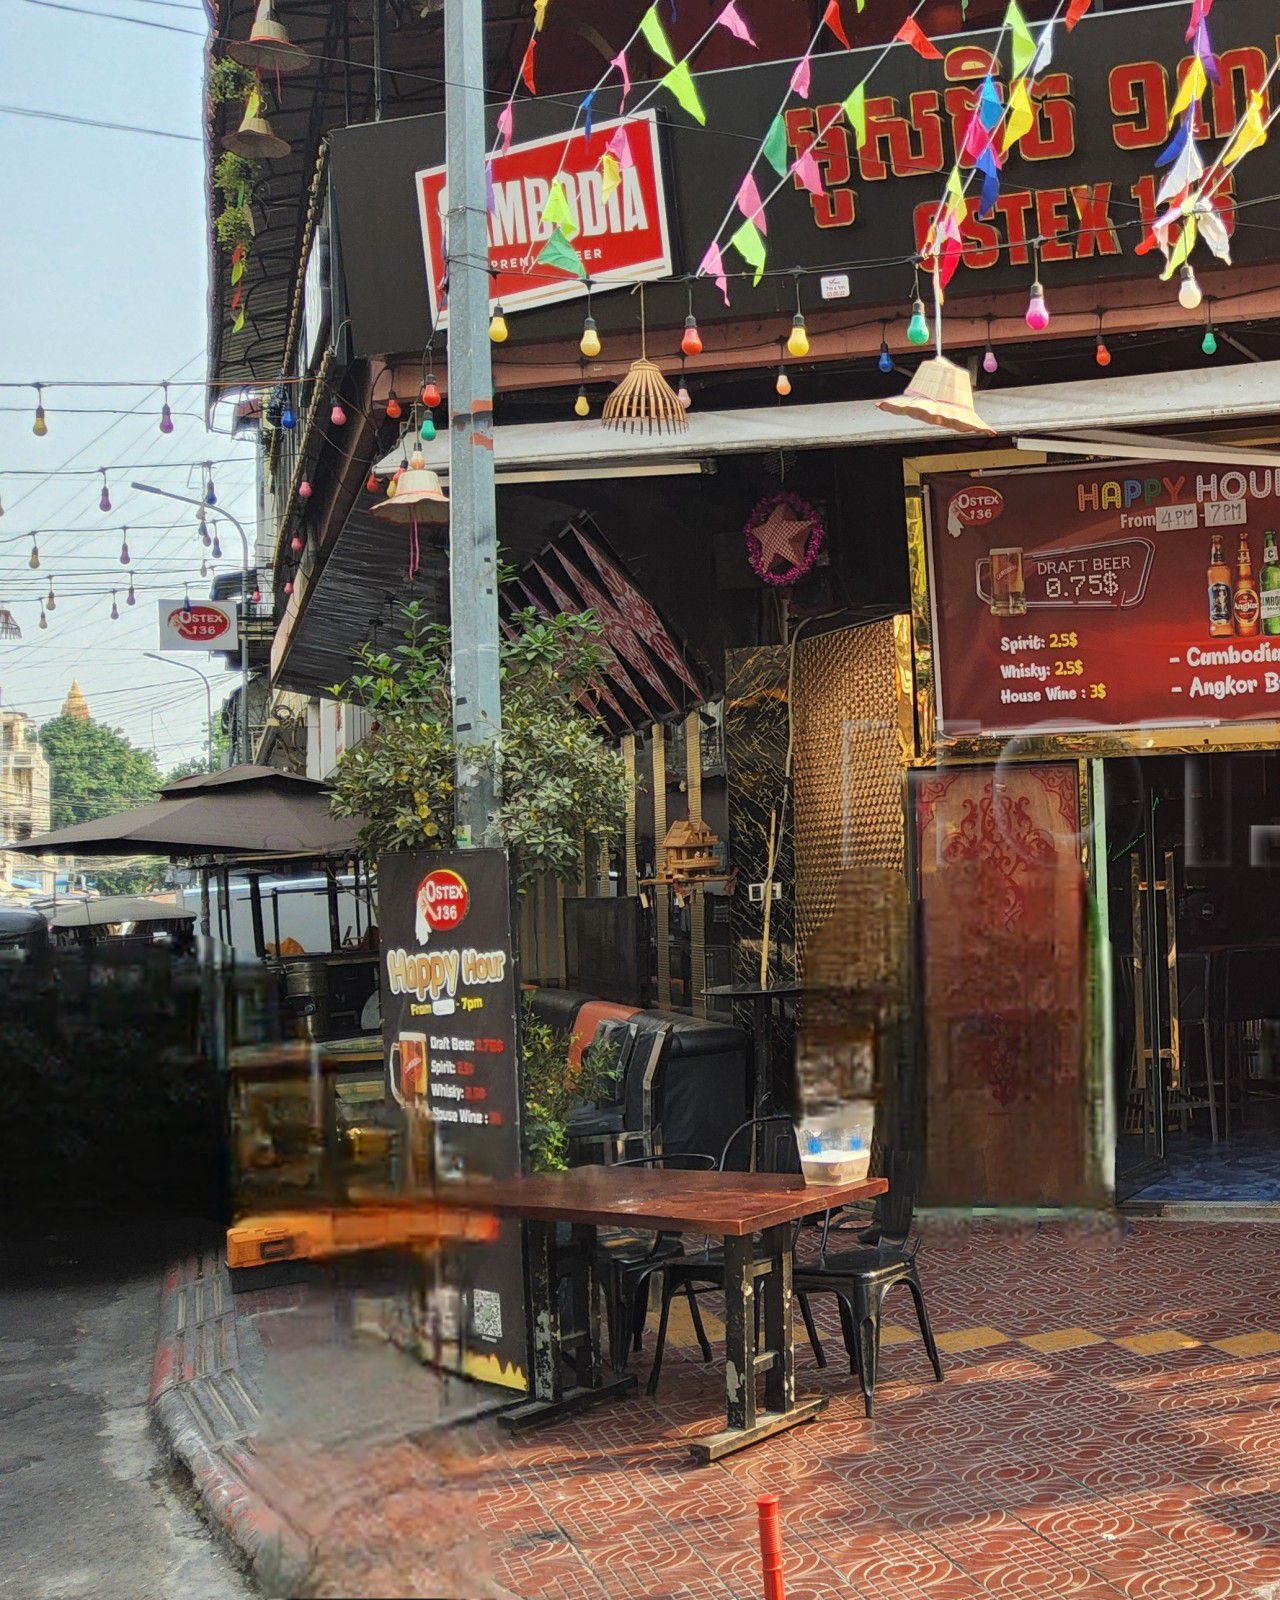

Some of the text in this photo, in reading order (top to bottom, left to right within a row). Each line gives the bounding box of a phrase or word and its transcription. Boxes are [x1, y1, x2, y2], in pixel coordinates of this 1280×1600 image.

[958, 493, 999, 509] OSTEX
[1076, 475, 1186, 512] HAPPY
[969, 508, 993, 520] 136
[1120, 513, 1156, 530] From
[1037, 558, 1089, 576] DRAFT
[1092, 555, 1132, 572] BEER
[1045, 570, 1119, 598] 0.75$
[178, 610, 223, 624] OSTEX
[191, 625, 216, 635] 136
[1000, 631, 1079, 655] Spirit: 2.5$
[1000, 659, 1084, 682] Whisky: 2.5$
[1001, 688, 1042, 705] House
[1045, 685, 1077, 702] Wine
[1089, 682, 1107, 700] 3$
[1189, 674, 1259, 701] Angkor
[425, 880, 464, 903] OSTEX
[437, 904, 458, 921] 136
[387, 948, 507, 1002] Happy Hour
[410, 1003, 432, 1016] From
[430, 1036, 450, 1050] Draft
[430, 1059, 456, 1075] Spirit:
[430, 1083, 464, 1101] Whisky:
[459, 1108, 483, 1124] Wine
